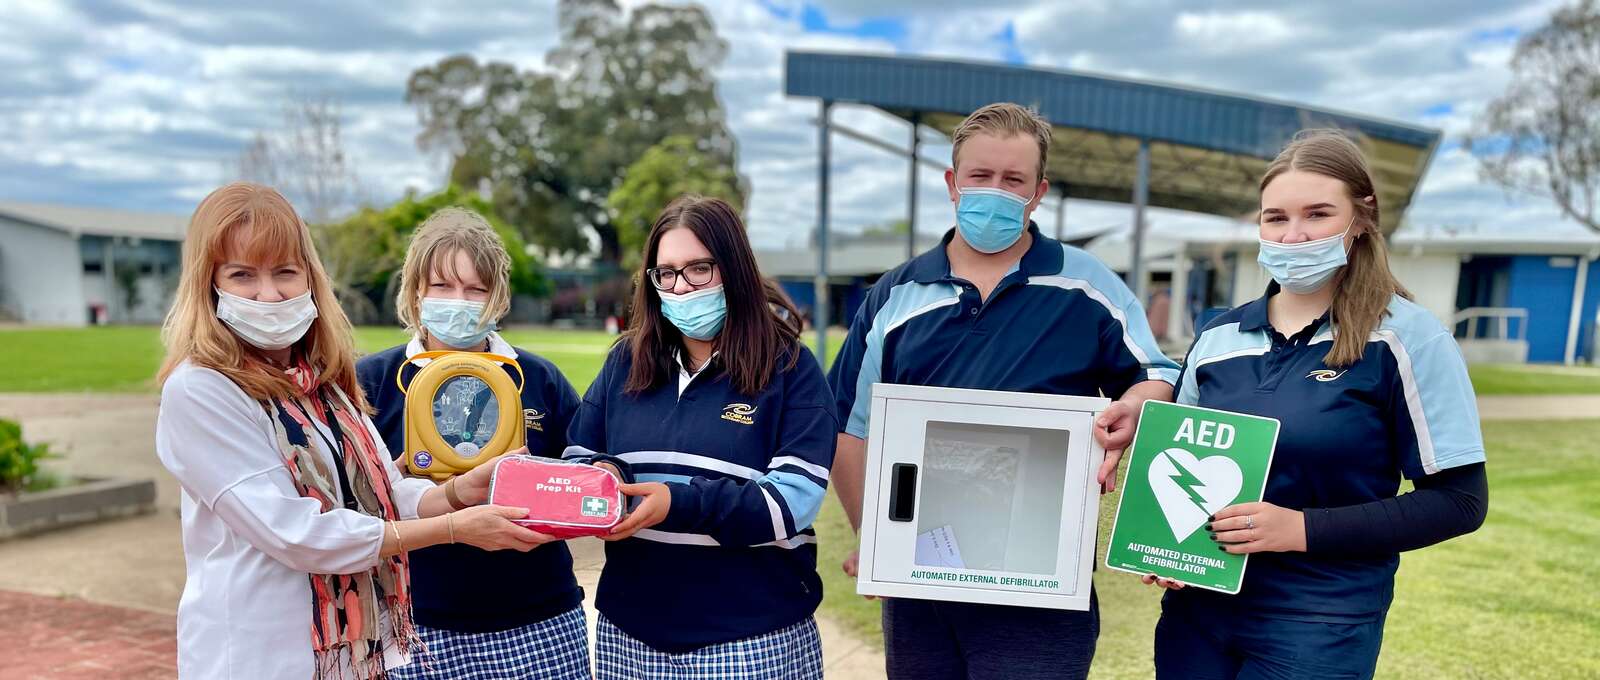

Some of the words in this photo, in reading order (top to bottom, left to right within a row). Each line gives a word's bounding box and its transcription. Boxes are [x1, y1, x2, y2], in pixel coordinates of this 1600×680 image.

[725, 411, 752, 421] COBRAM
[1173, 417, 1236, 450] AED
[536, 483, 562, 493] Prep
[565, 485, 582, 493] Kit
[548, 476, 571, 485] AED
[1127, 542, 1181, 560] AUTOMATED
[1181, 553, 1226, 570] EXTERNAL
[1142, 554, 1207, 576] DEFIBRILLATOR
[910, 570, 958, 582] AUTOMATED
[959, 573, 998, 585] EXTERNAL
[1000, 576, 1059, 589] DEFIBRILLATOR
